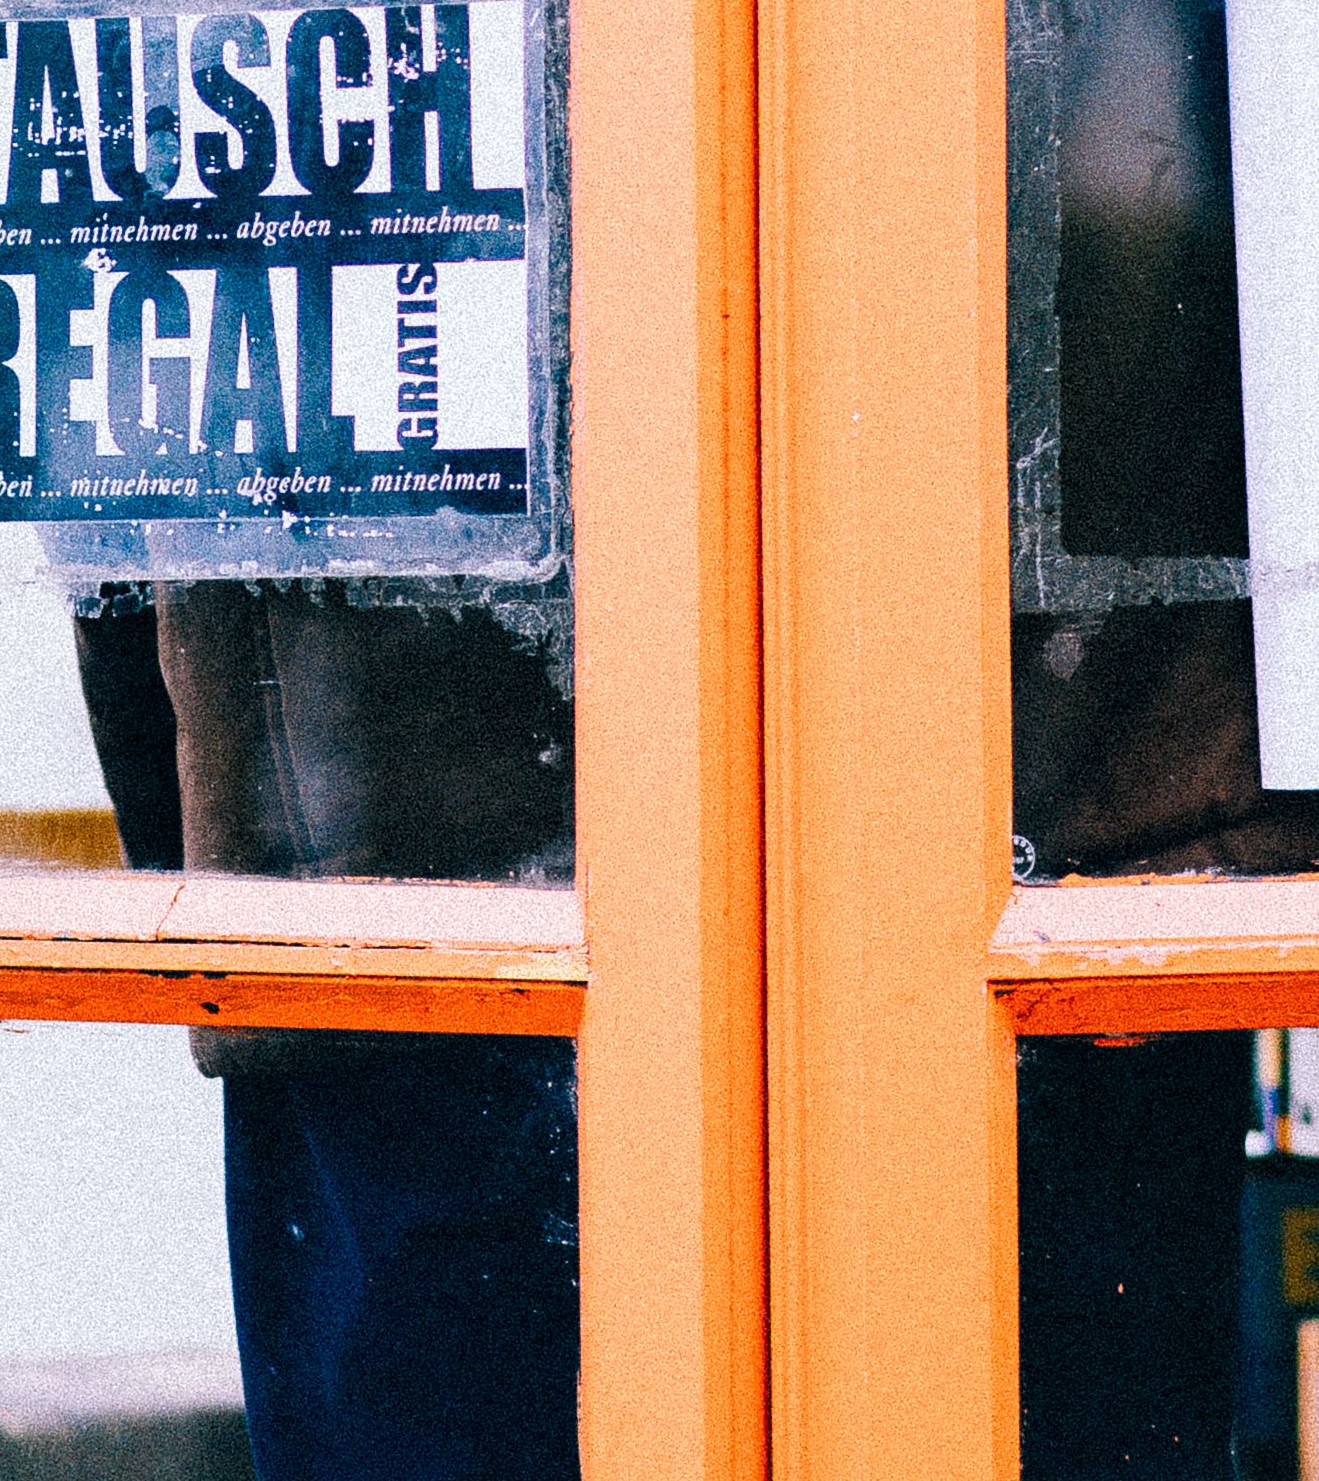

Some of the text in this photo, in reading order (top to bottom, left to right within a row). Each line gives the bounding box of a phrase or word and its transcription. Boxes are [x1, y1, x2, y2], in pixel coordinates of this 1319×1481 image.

[69, 213, 199, 244] mitnehmen
[235, 210, 332, 247] abgeben
[369, 205, 501, 235] mitnehmen
[396, 260, 440, 450] GRATIS
[69, 468, 200, 498] mitnehmen
[235, 465, 332, 504] abgeben
[370, 463, 502, 493] mitnehmen
